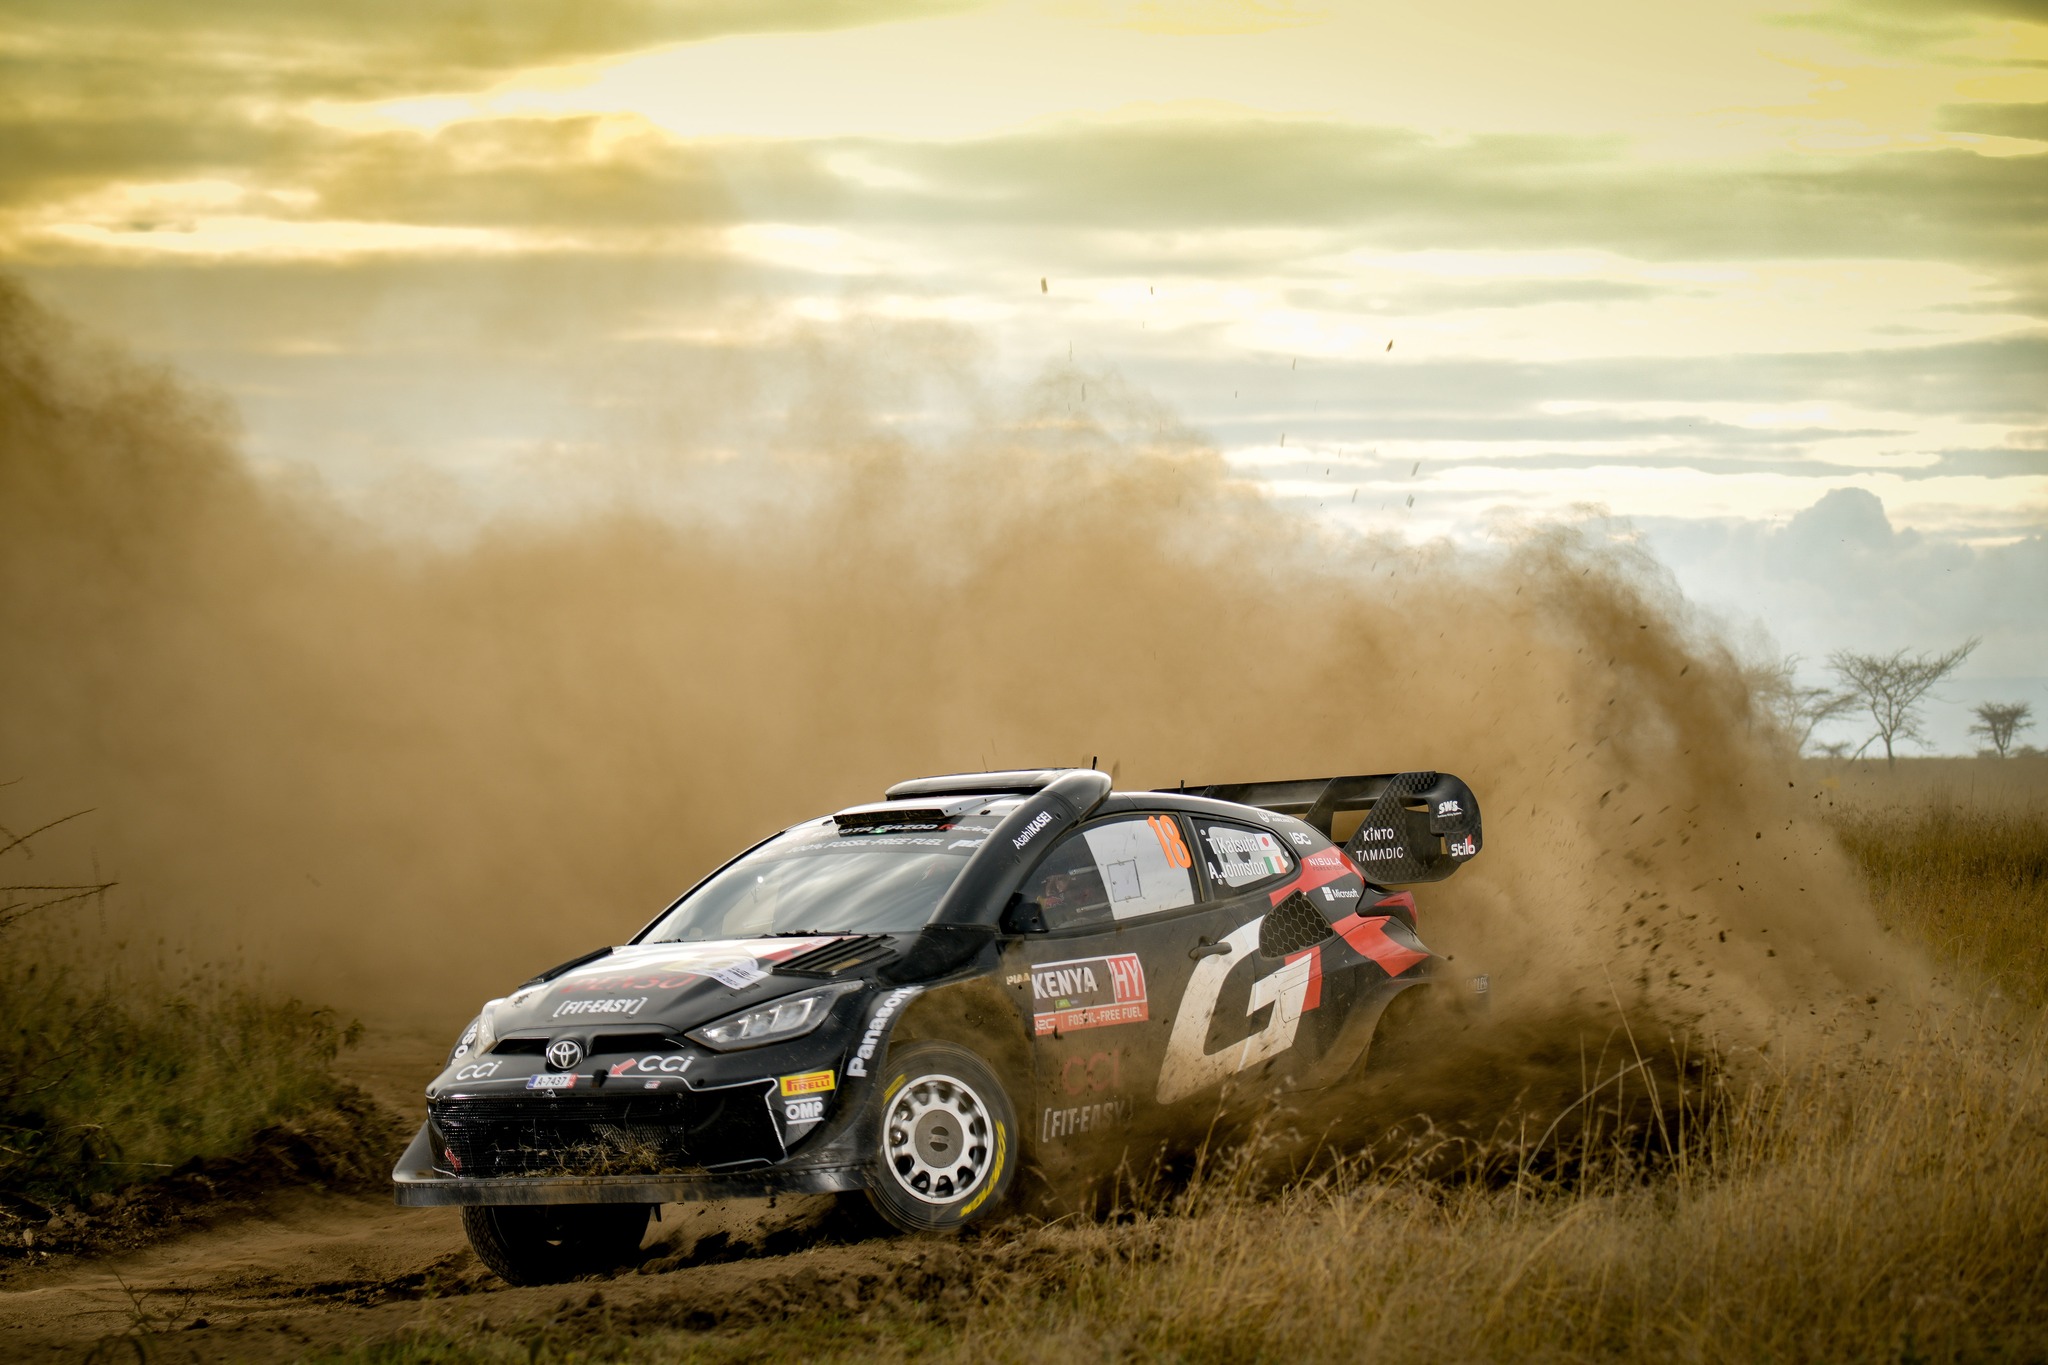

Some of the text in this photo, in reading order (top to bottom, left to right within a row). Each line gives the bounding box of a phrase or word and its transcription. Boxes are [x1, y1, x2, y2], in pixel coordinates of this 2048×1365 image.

[1012, 811, 1053, 850] AsahiKASEI
[1147, 814, 1192, 869] 18
[1451, 834, 1476, 857] Stilo
[1308, 857, 1342, 866] NISULA
[1331, 888, 1360, 899] Microsoft
[1031, 958, 1140, 1000] KENYA HY
[1122, 1006, 1143, 1018] FUEL
[786, 1074, 831, 1093] PIRELLI
[785, 1100, 824, 1120] OMP
